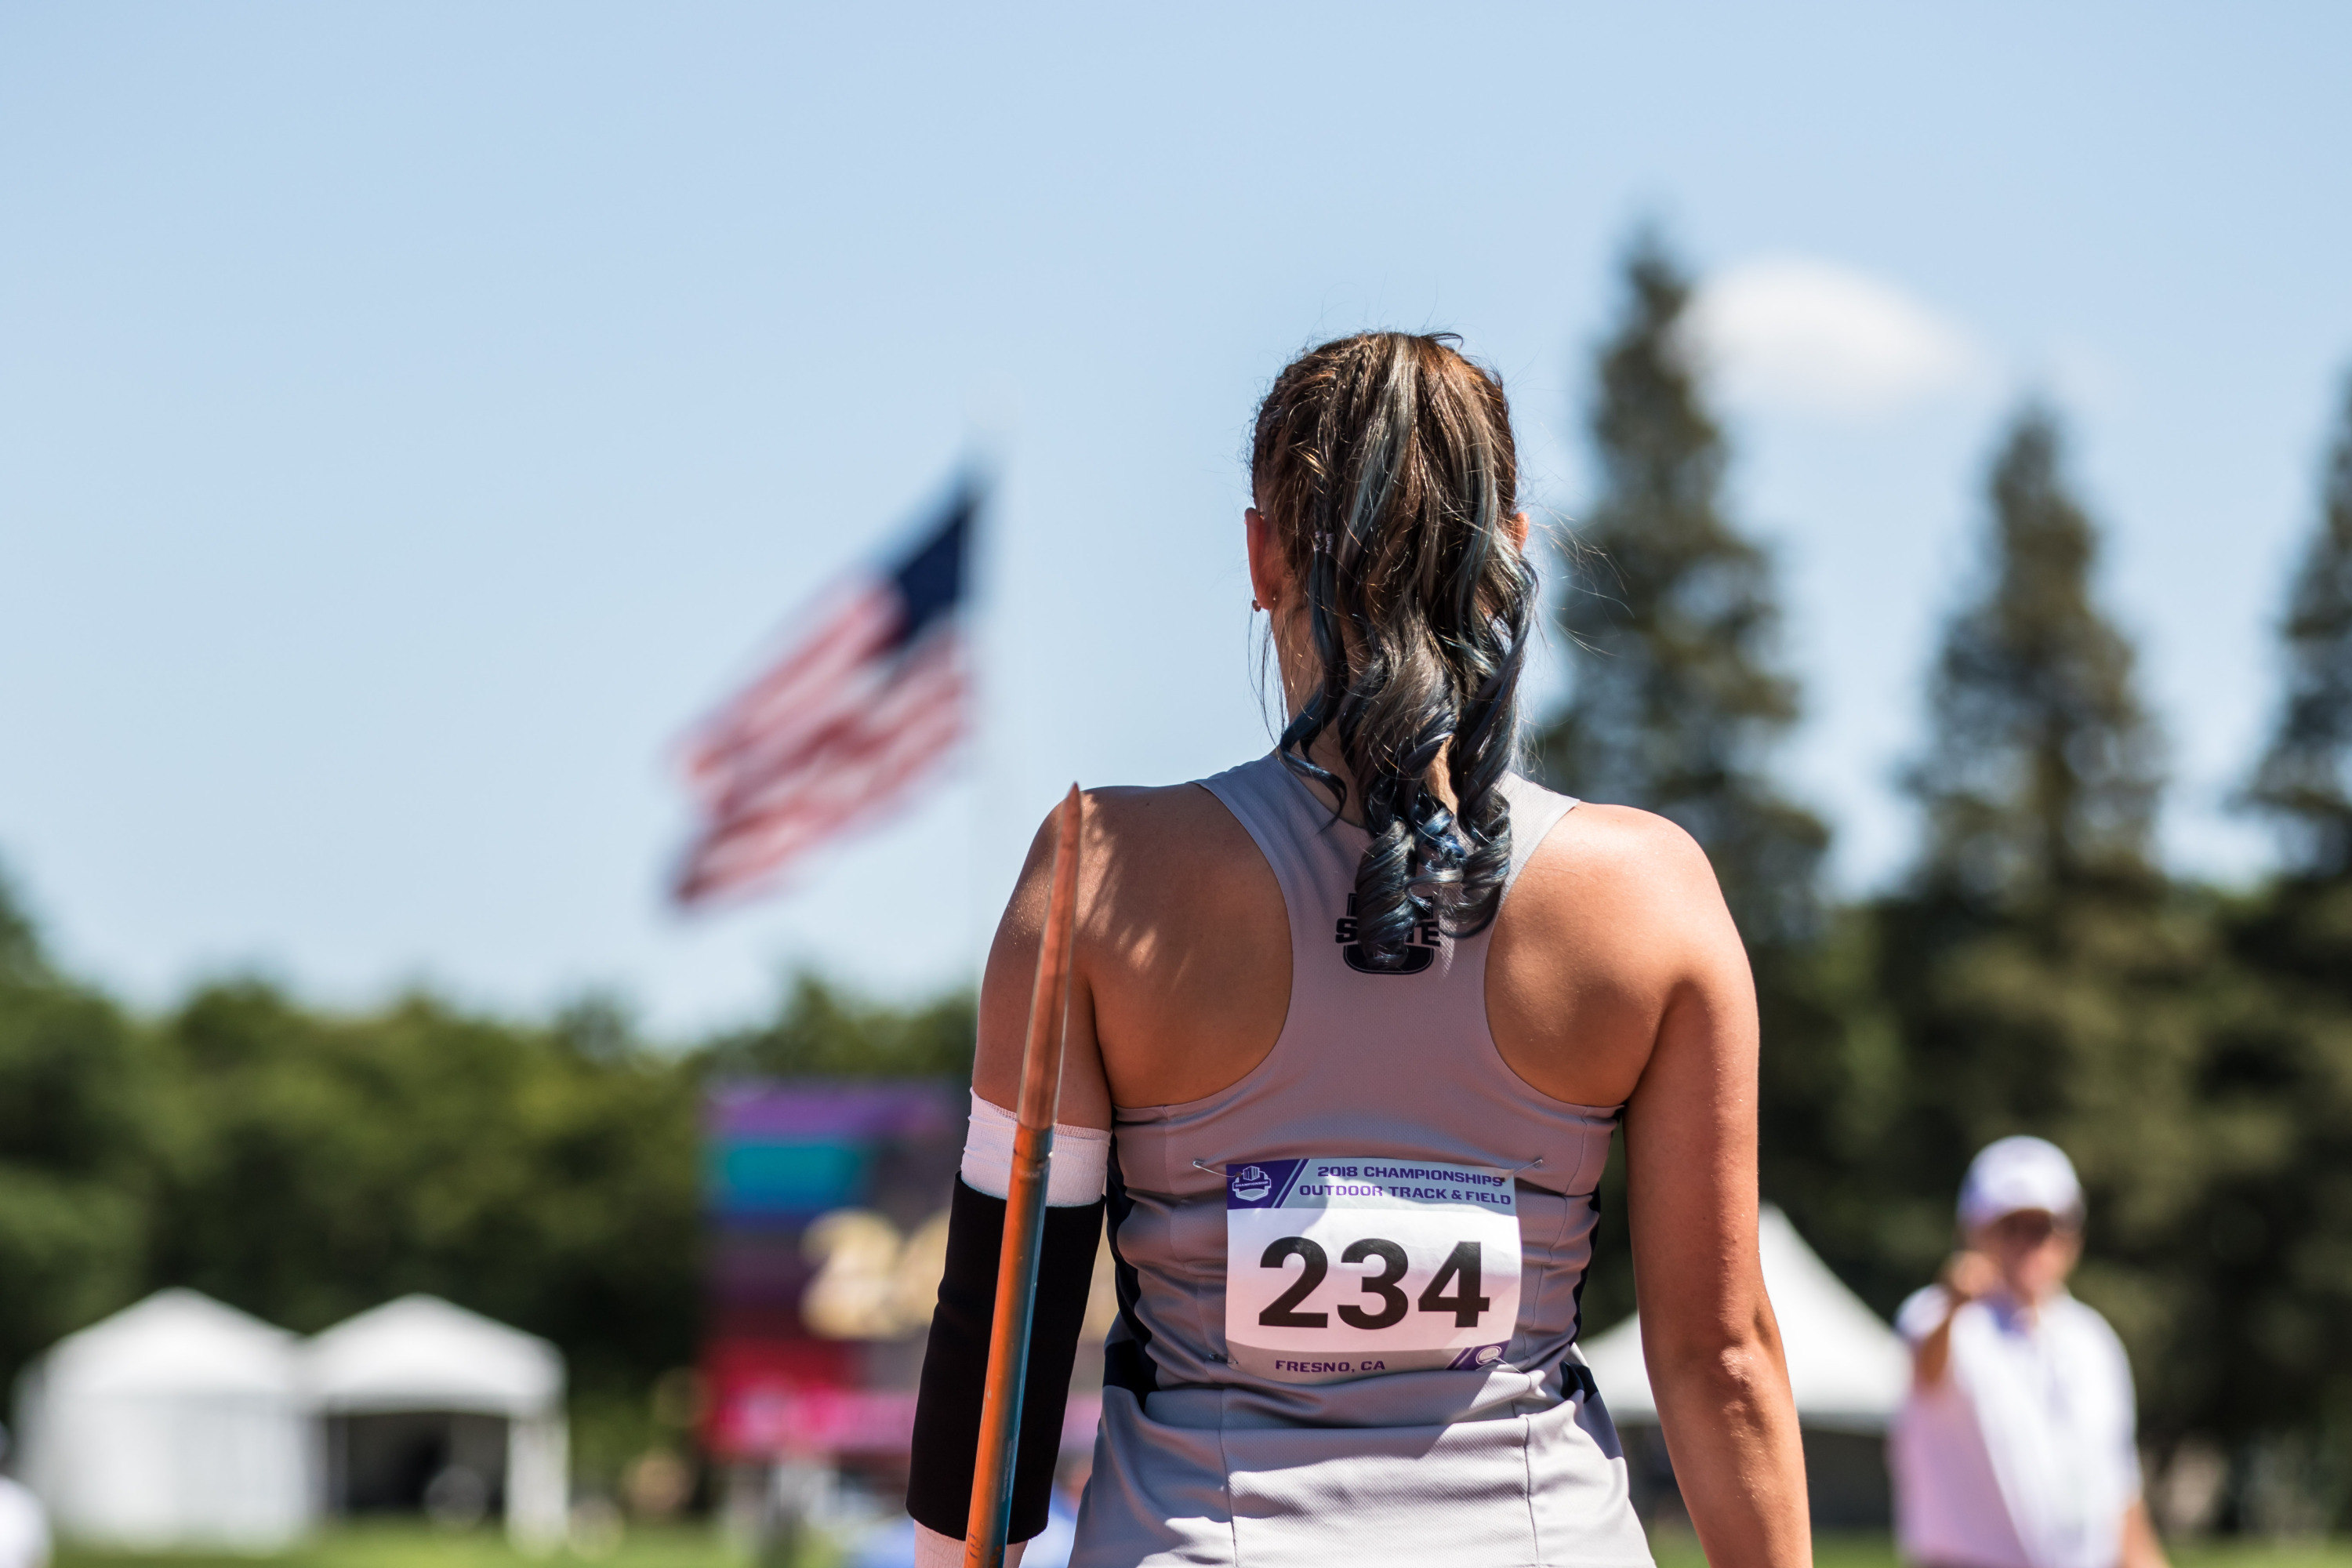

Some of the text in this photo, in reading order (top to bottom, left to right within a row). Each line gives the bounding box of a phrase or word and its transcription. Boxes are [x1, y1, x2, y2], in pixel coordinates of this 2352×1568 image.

[1318, 1166, 1503, 1187] 2018 CHAMPIONSHIPS
[1299, 1185, 1511, 1205] OUTDOOR TRACK & FIELD
[1258, 1236, 1490, 1330] 234
[1275, 1360, 1386, 1374] FRESNO, CA
